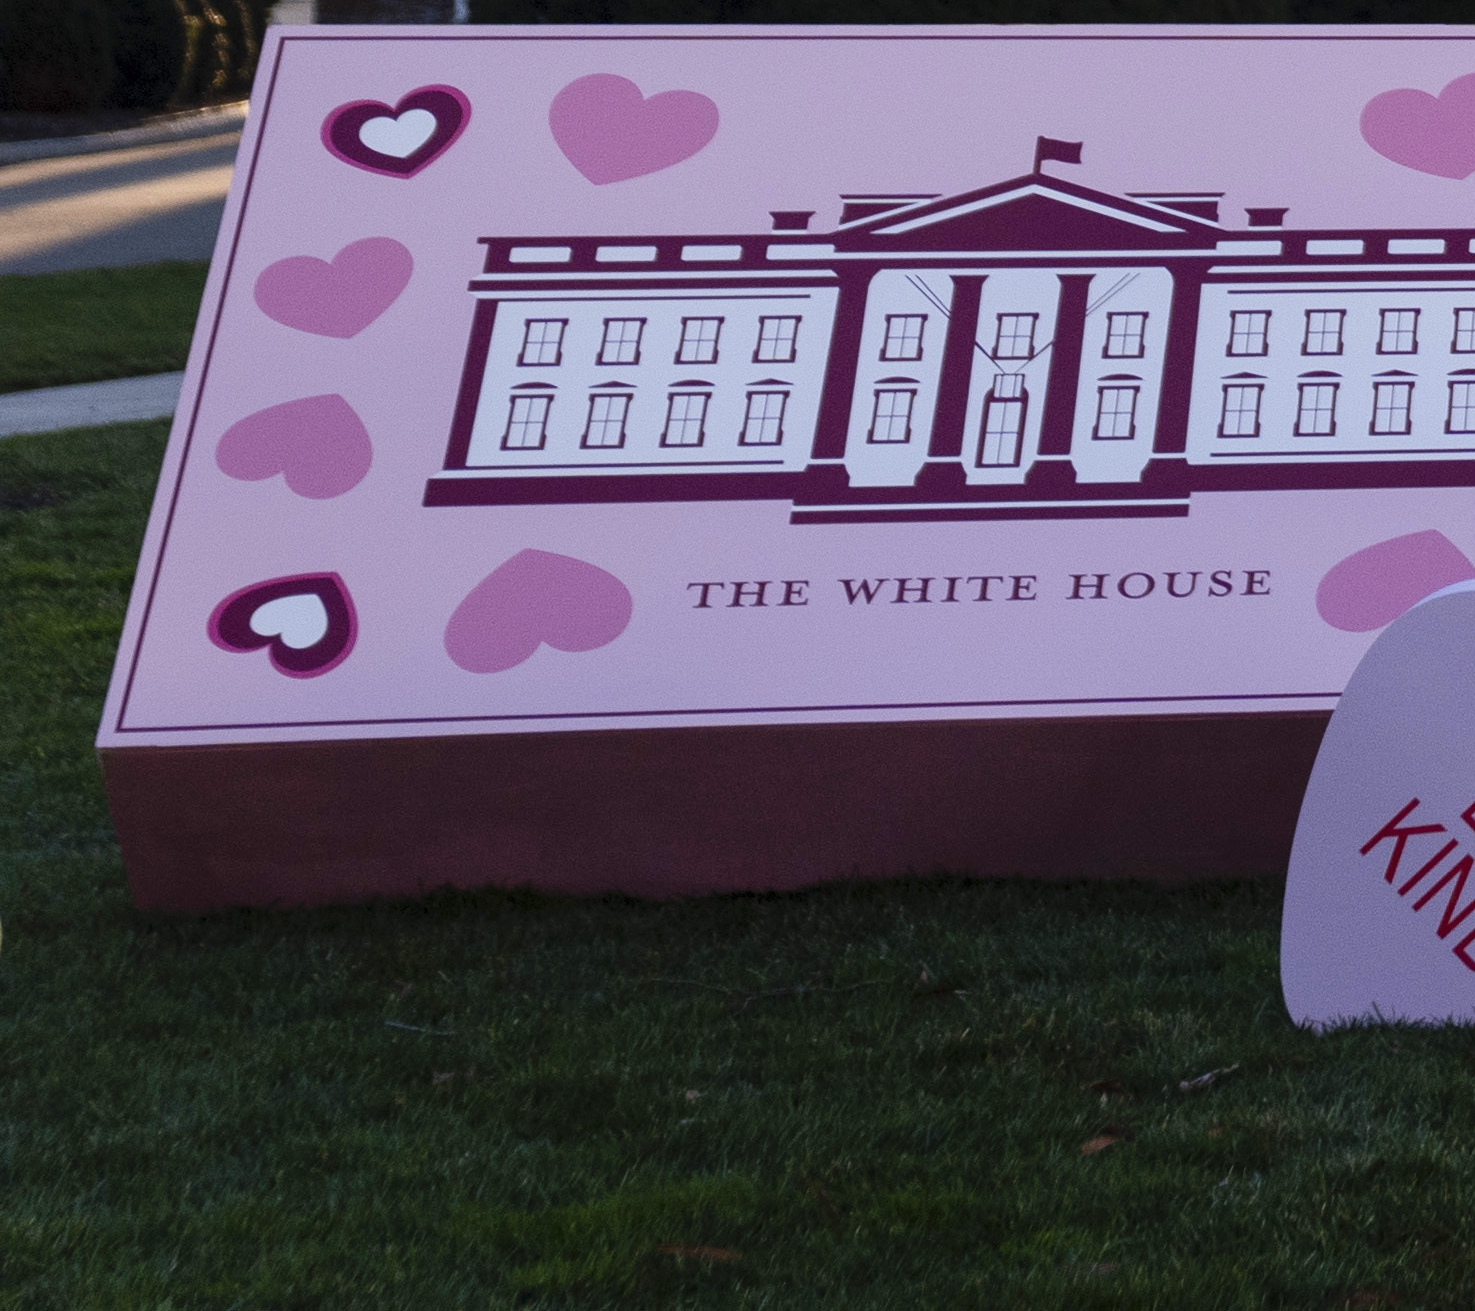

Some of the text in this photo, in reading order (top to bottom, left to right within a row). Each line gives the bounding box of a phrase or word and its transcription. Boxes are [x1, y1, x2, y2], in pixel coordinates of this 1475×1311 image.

[686, 569, 1272, 610] THE WHITE HOUSE
